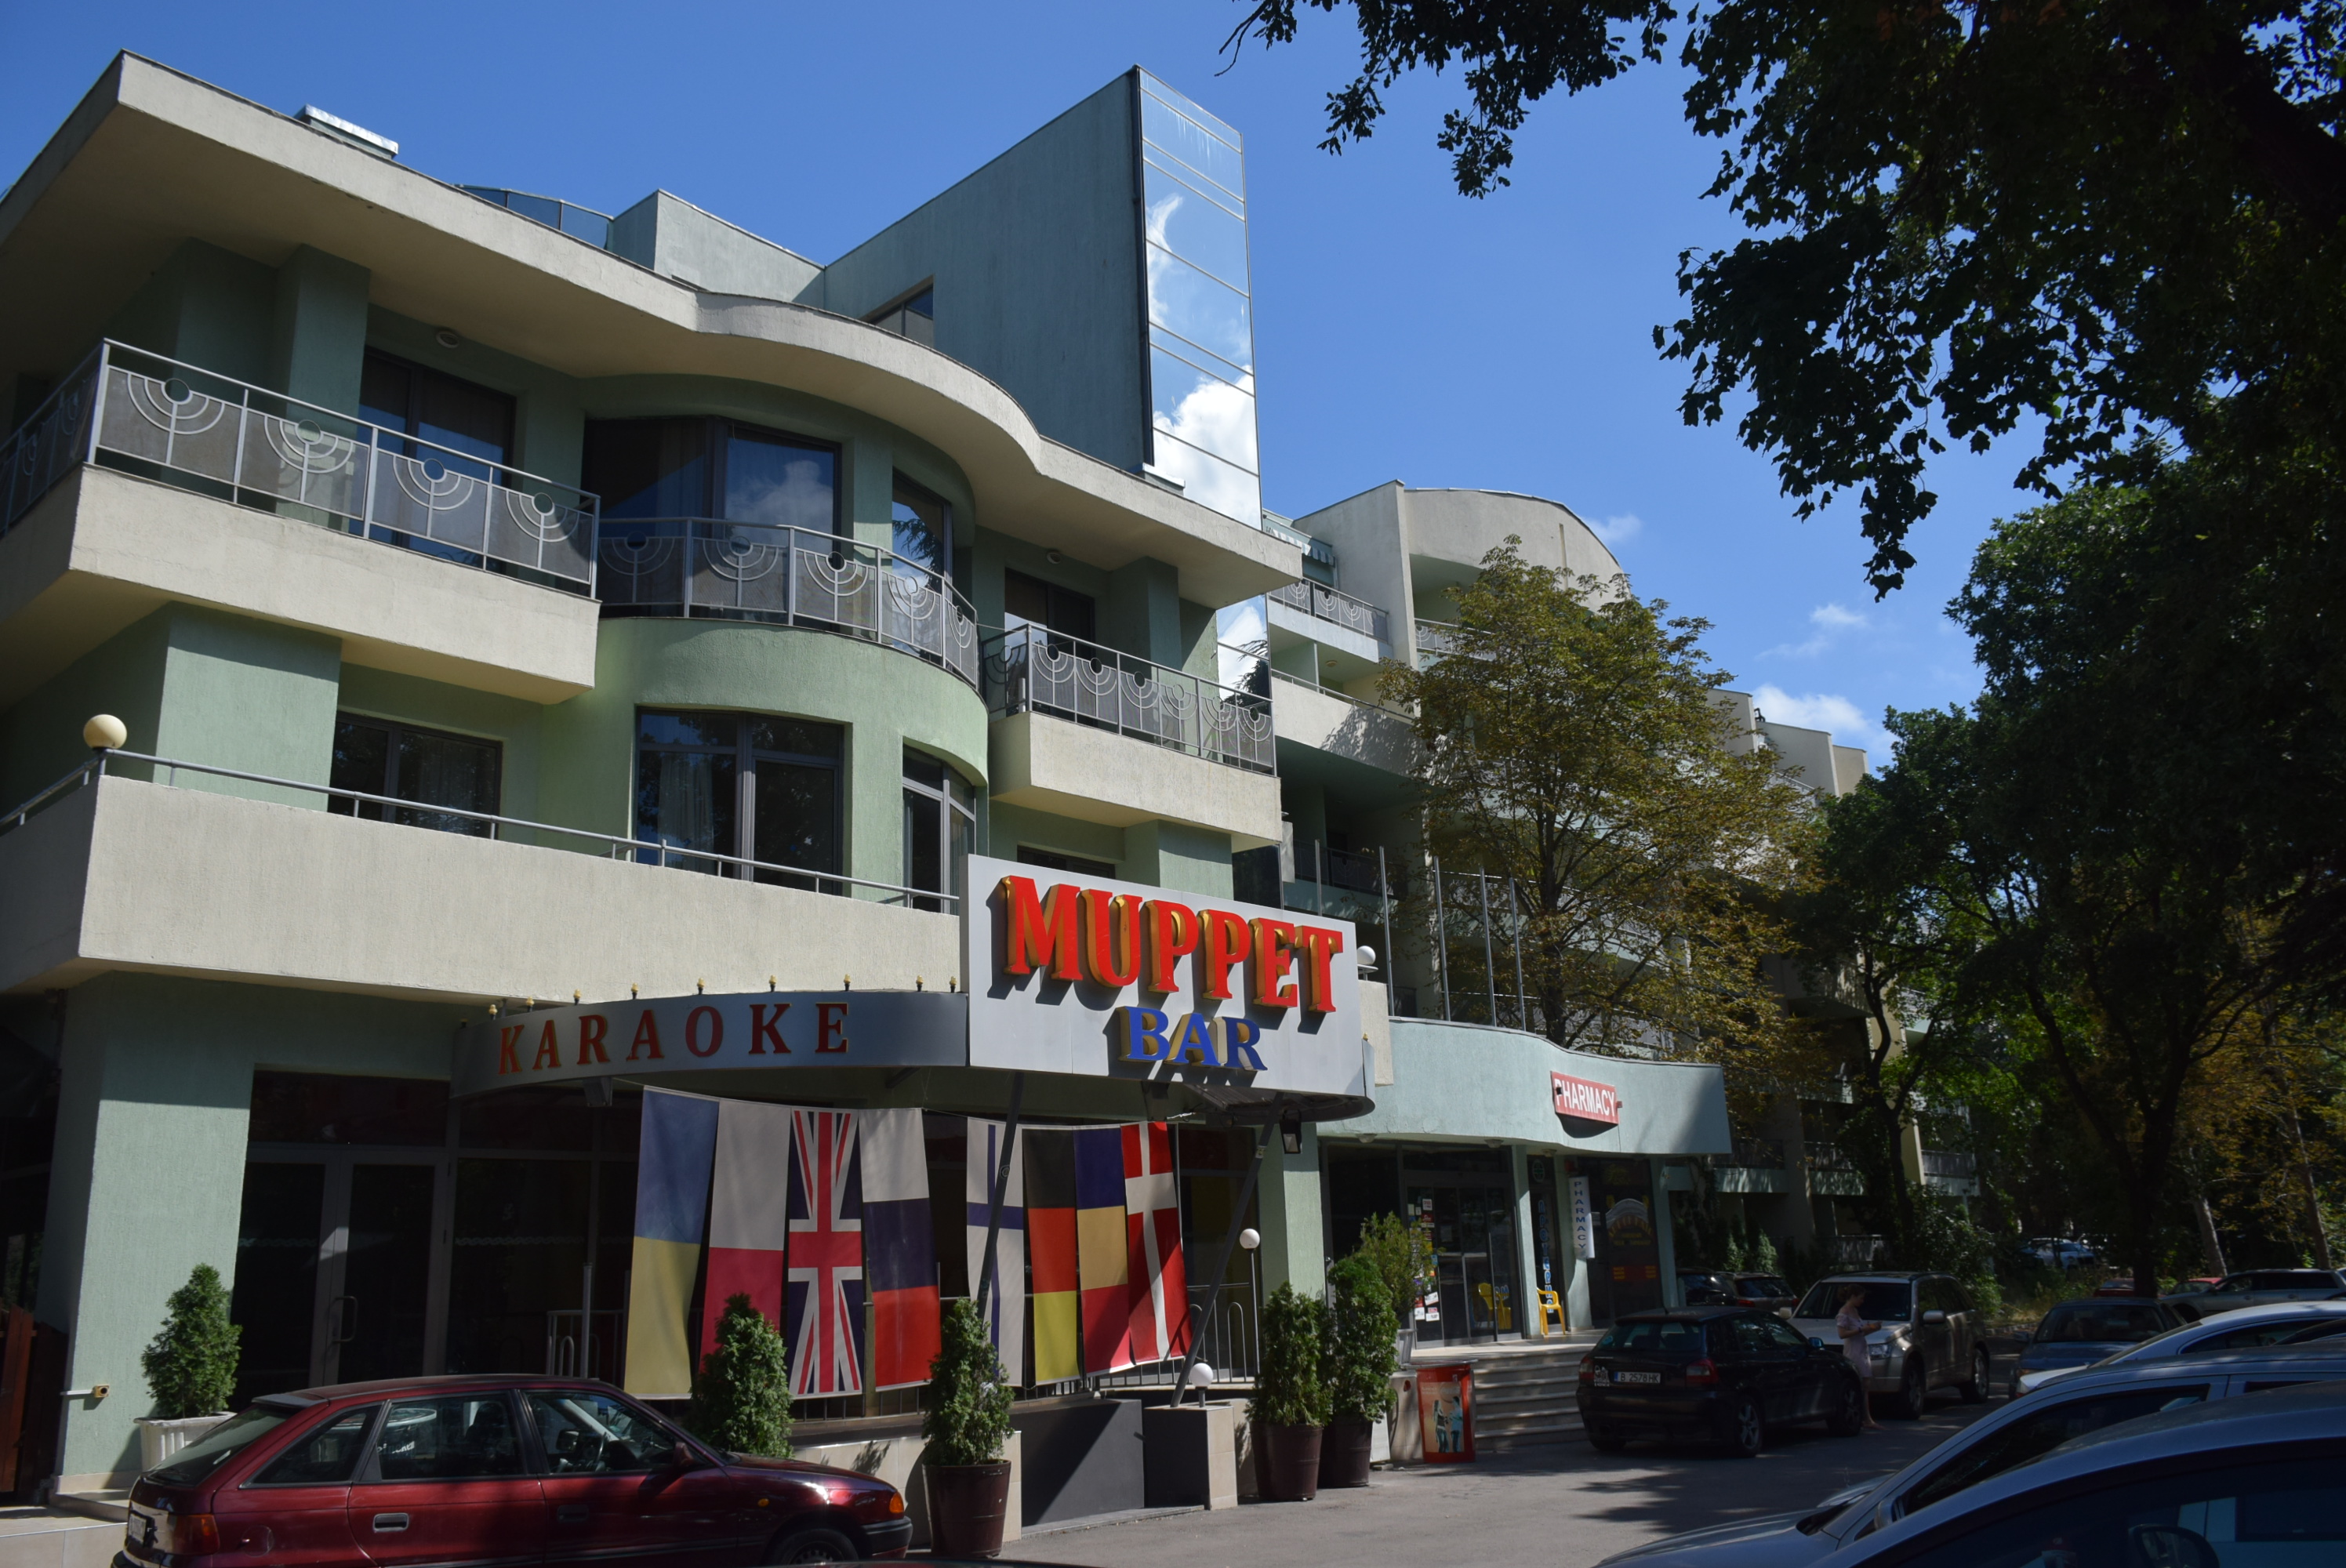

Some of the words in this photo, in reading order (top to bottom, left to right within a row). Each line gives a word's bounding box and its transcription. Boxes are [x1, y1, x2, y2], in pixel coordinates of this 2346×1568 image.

[1003, 875, 1343, 1013] MUPPET
[498, 1002, 850, 1076] KARAOKE
[1115, 1006, 1268, 1071] BAR
[1554, 1078, 1615, 1117] PHARMACY
[1574, 1181, 1587, 1249] PHARMACY
